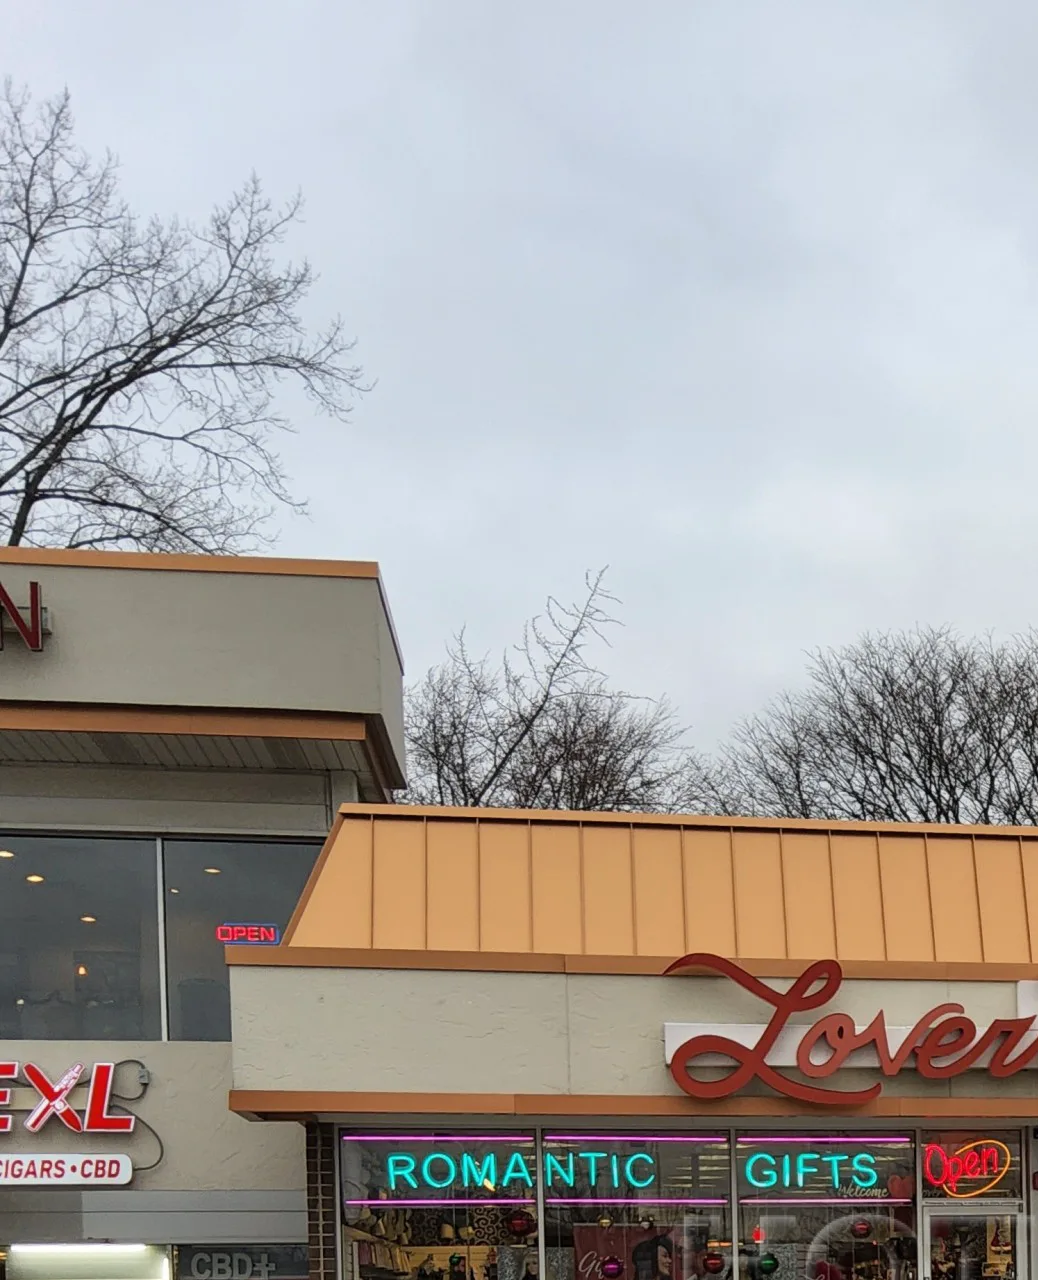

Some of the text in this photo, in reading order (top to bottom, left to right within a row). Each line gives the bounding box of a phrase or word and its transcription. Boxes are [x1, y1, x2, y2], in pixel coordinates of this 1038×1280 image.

[217, 925, 275, 942] OPEN
[0, 1159, 121, 1179] IGARS CBD
[386, 1151, 879, 1190] ROMANTIC GIFTS
[923, 1143, 999, 1193] Open
[837, 1182, 890, 1198] Welcome
